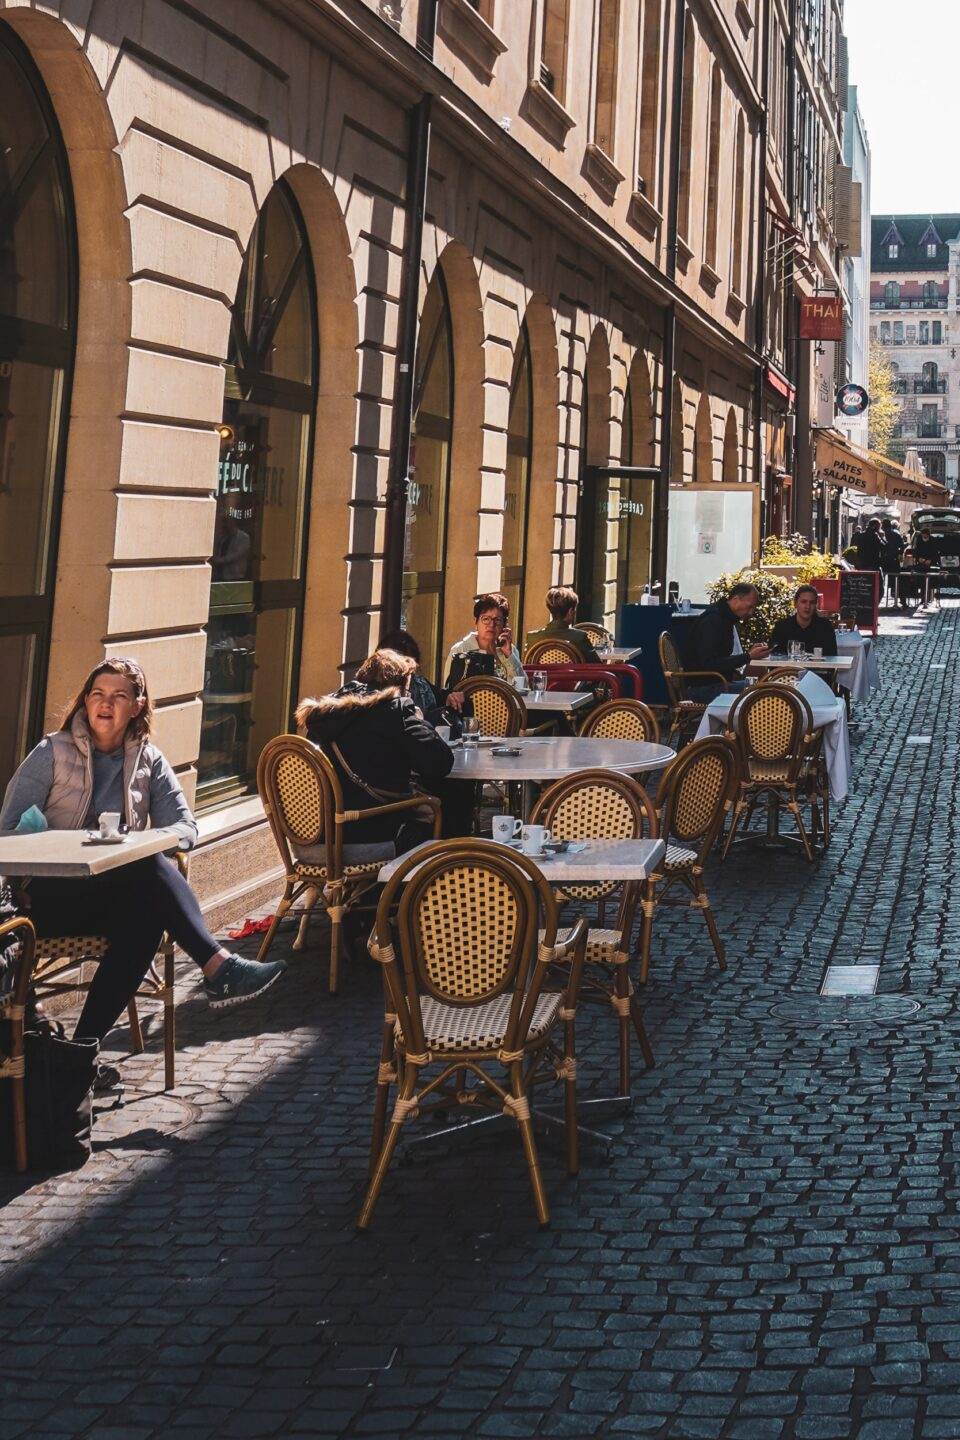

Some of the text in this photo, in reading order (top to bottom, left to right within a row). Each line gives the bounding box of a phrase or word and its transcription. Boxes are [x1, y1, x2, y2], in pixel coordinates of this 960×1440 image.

[833, 459, 862, 476] PÂTES
[822, 468, 867, 489] SALADES
[892, 487, 928, 500] PIZZAS
